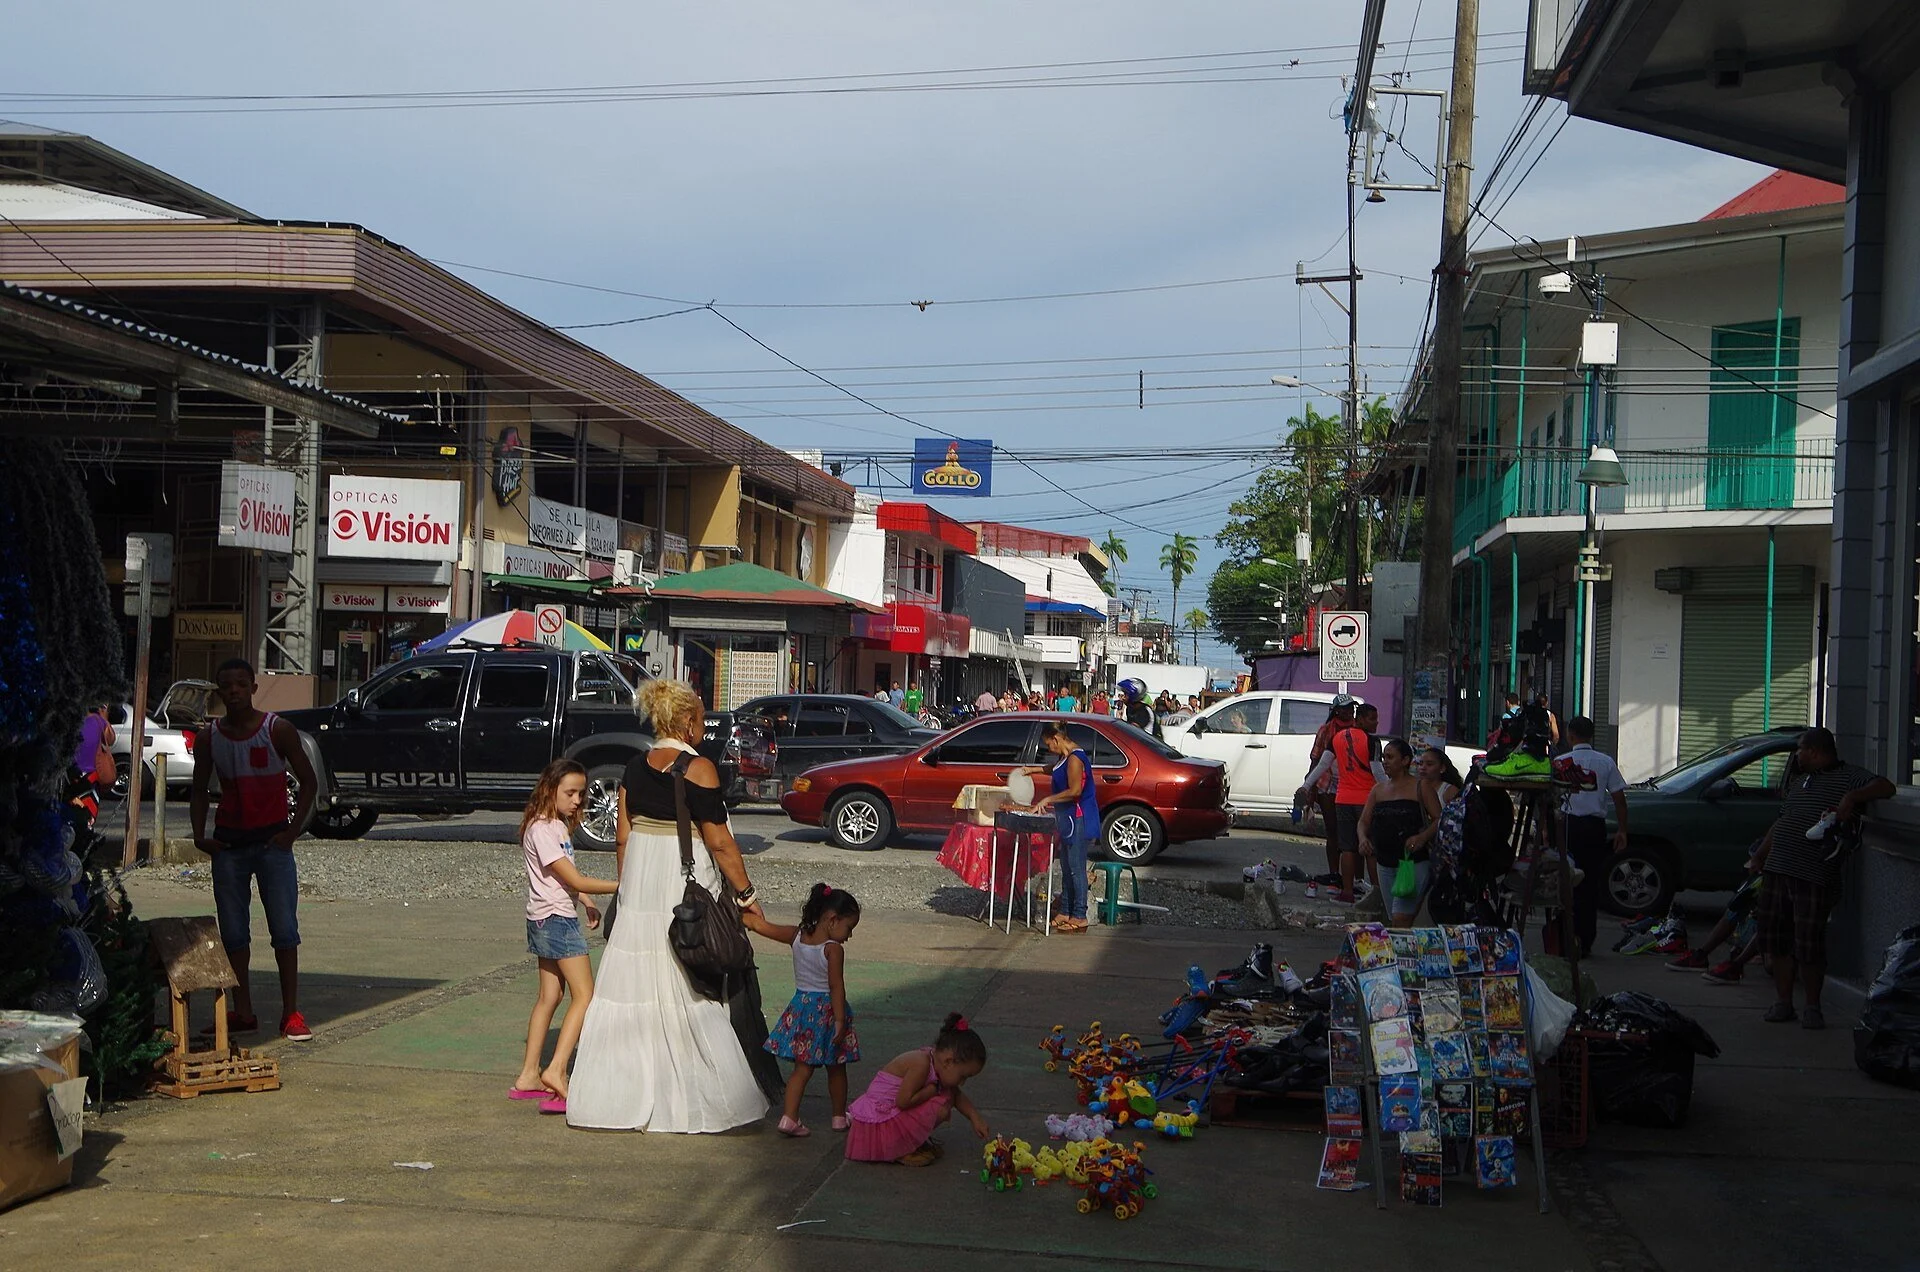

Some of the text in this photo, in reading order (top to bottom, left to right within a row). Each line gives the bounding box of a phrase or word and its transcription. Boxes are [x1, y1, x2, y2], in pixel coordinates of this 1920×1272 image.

[239, 478, 271, 494] OPTICAS
[924, 472, 980, 487] GOLLO
[333, 491, 398, 504] OPTICAS
[253, 500, 291, 537] Visión
[549, 507, 561, 523] SE
[362, 511, 450, 545] Visión
[531, 523, 564, 544] INFORMES
[514, 556, 542, 574] OPTICAS
[343, 594, 375, 606] Visión
[407, 596, 439, 607] Visión
[543, 635, 556, 646] NO
[1332, 648, 1357, 656] ZONA DE
[1328, 661, 1360, 669] DESCARGA
[371, 772, 456, 788] ISUZU
